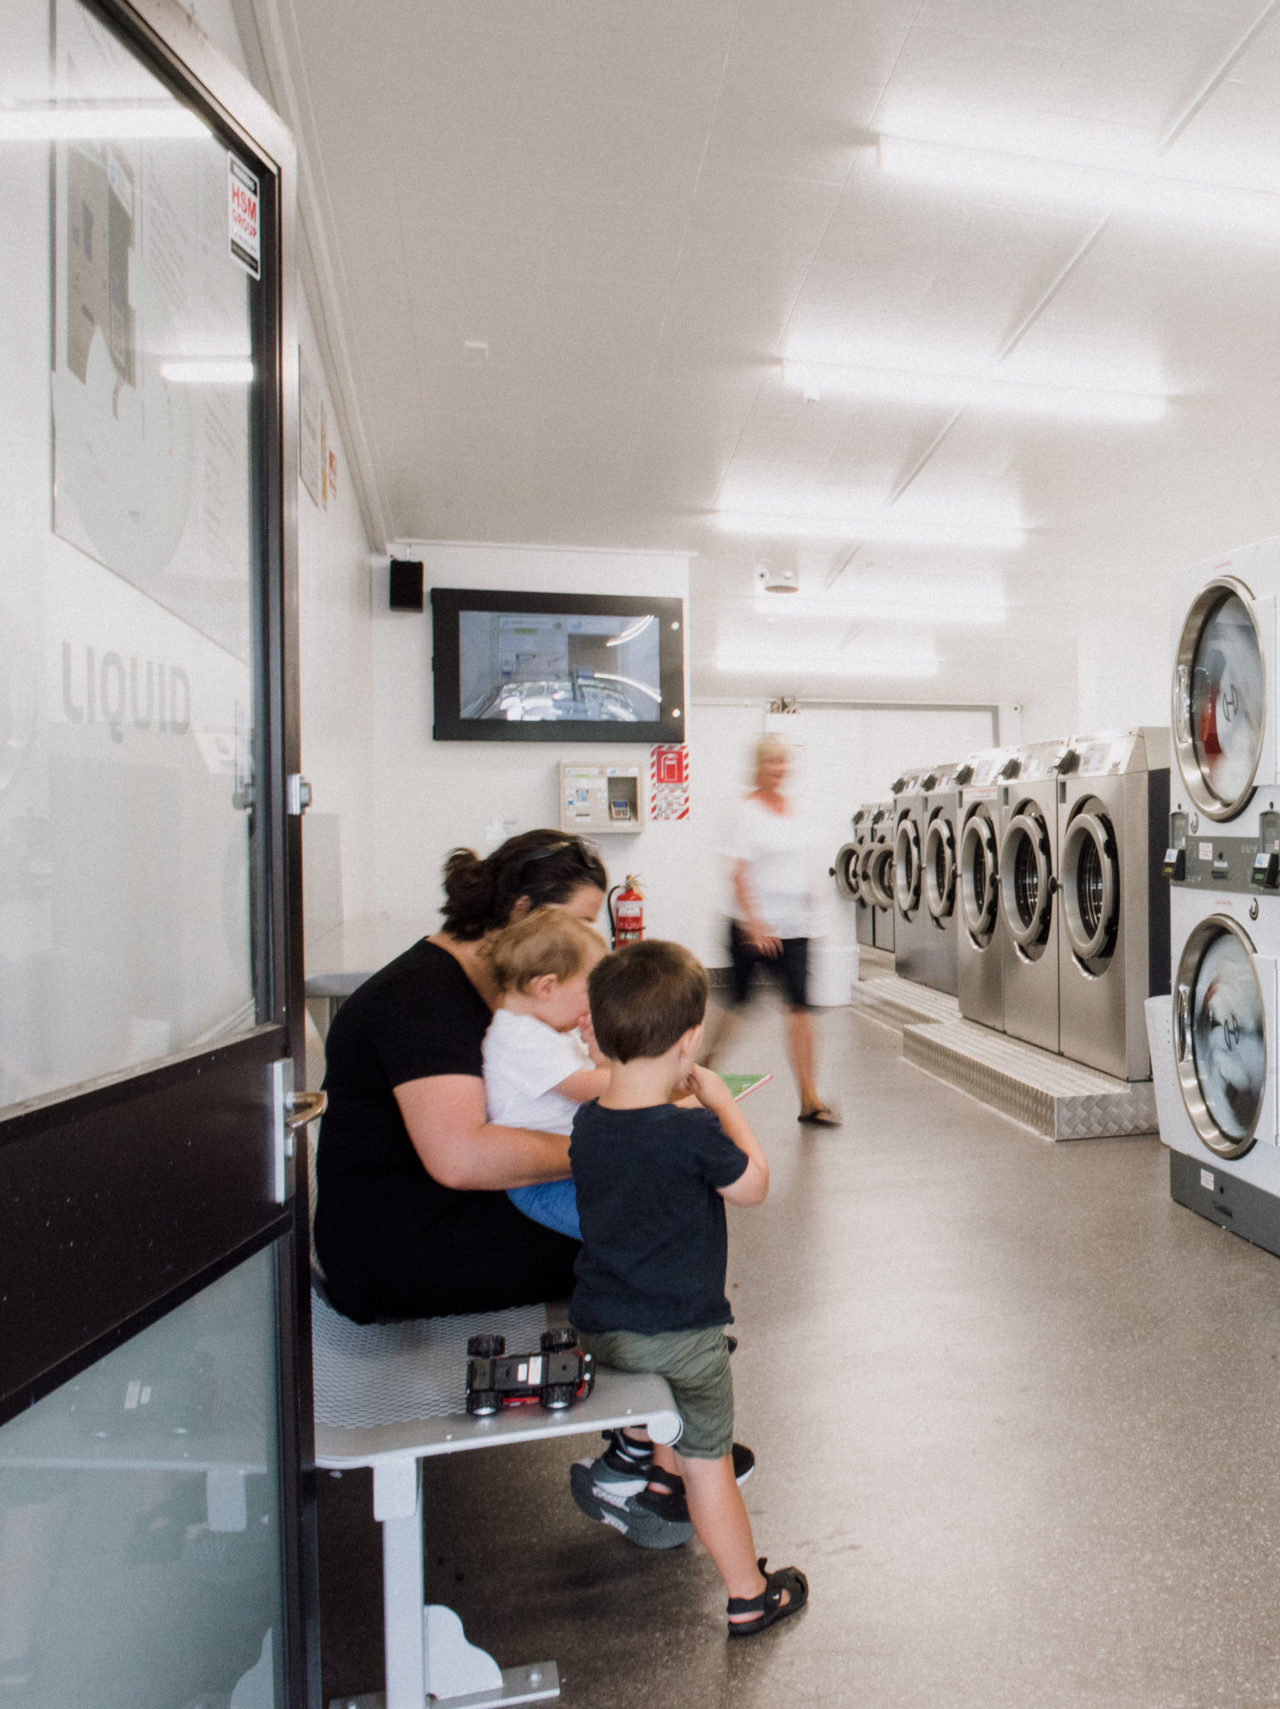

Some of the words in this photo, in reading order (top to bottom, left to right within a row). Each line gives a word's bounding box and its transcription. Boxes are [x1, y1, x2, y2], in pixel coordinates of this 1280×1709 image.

[231, 181, 257, 224] HSM
[231, 207, 257, 238] GROUP
[61, 640, 192, 744] LIQUID
